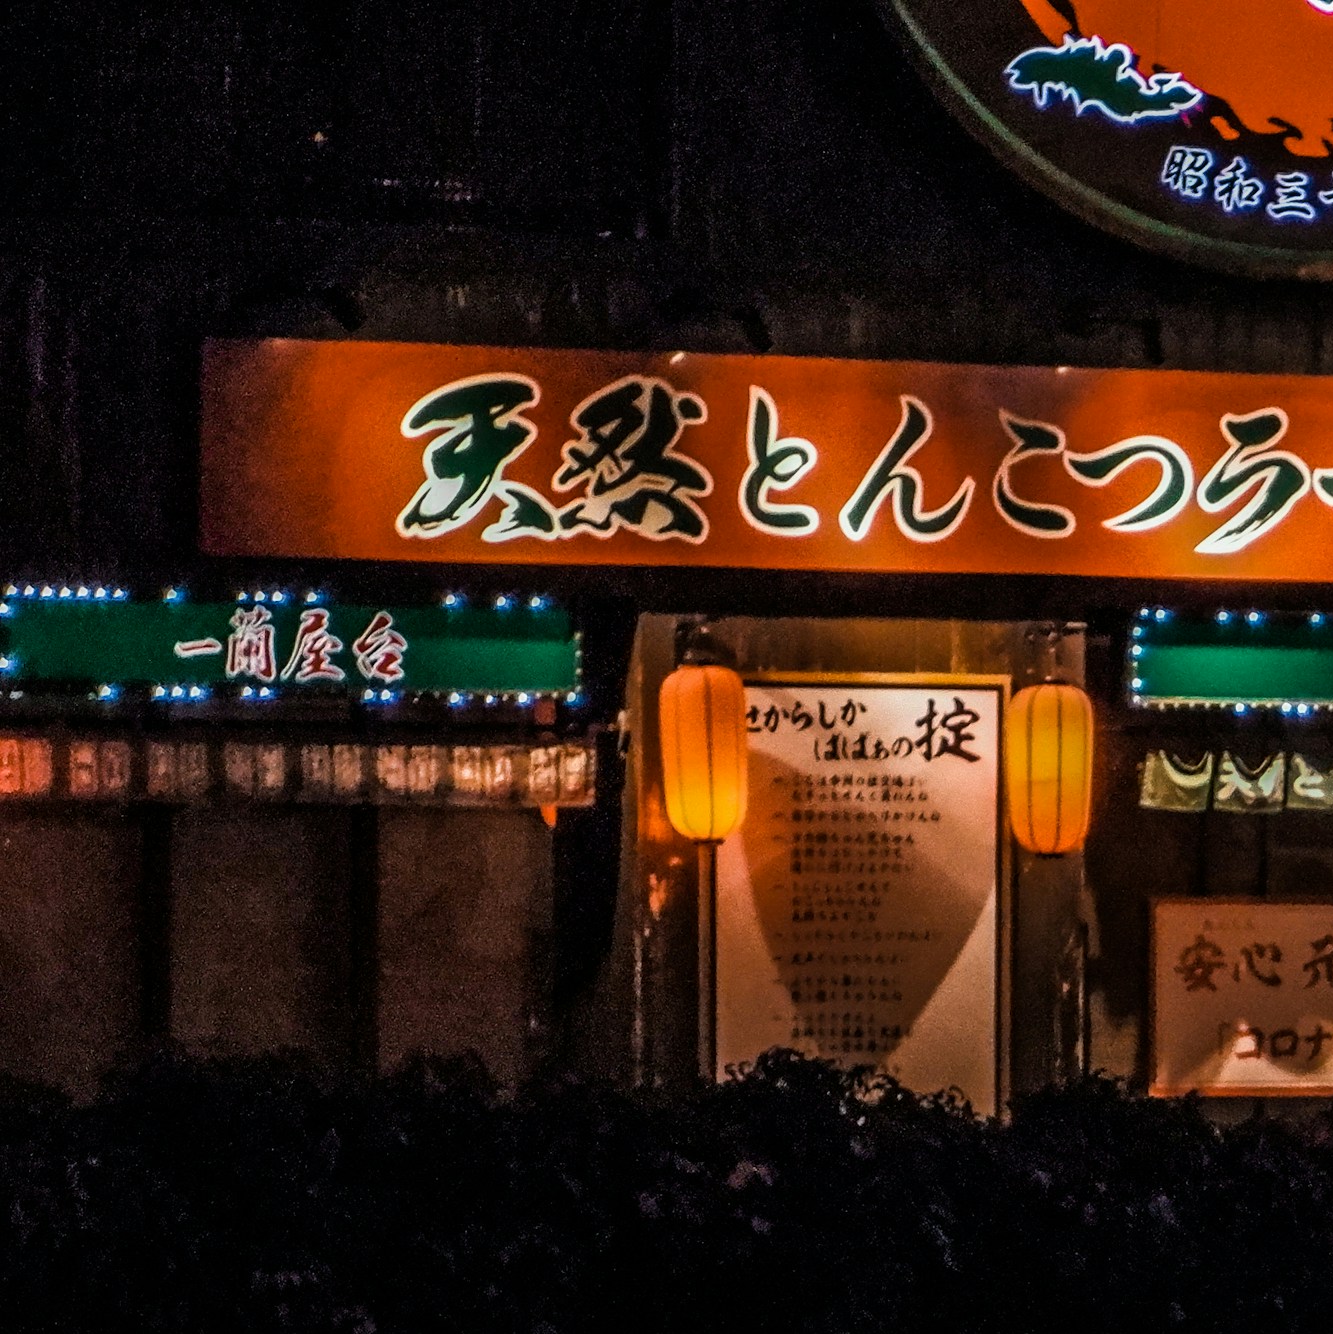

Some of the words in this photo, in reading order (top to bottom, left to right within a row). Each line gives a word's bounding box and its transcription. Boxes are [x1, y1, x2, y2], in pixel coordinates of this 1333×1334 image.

[173, 604, 409, 683] 一蘭屋台
[915, 697, 981, 764] 掟
[1176, 934, 1283, 993] 安心
